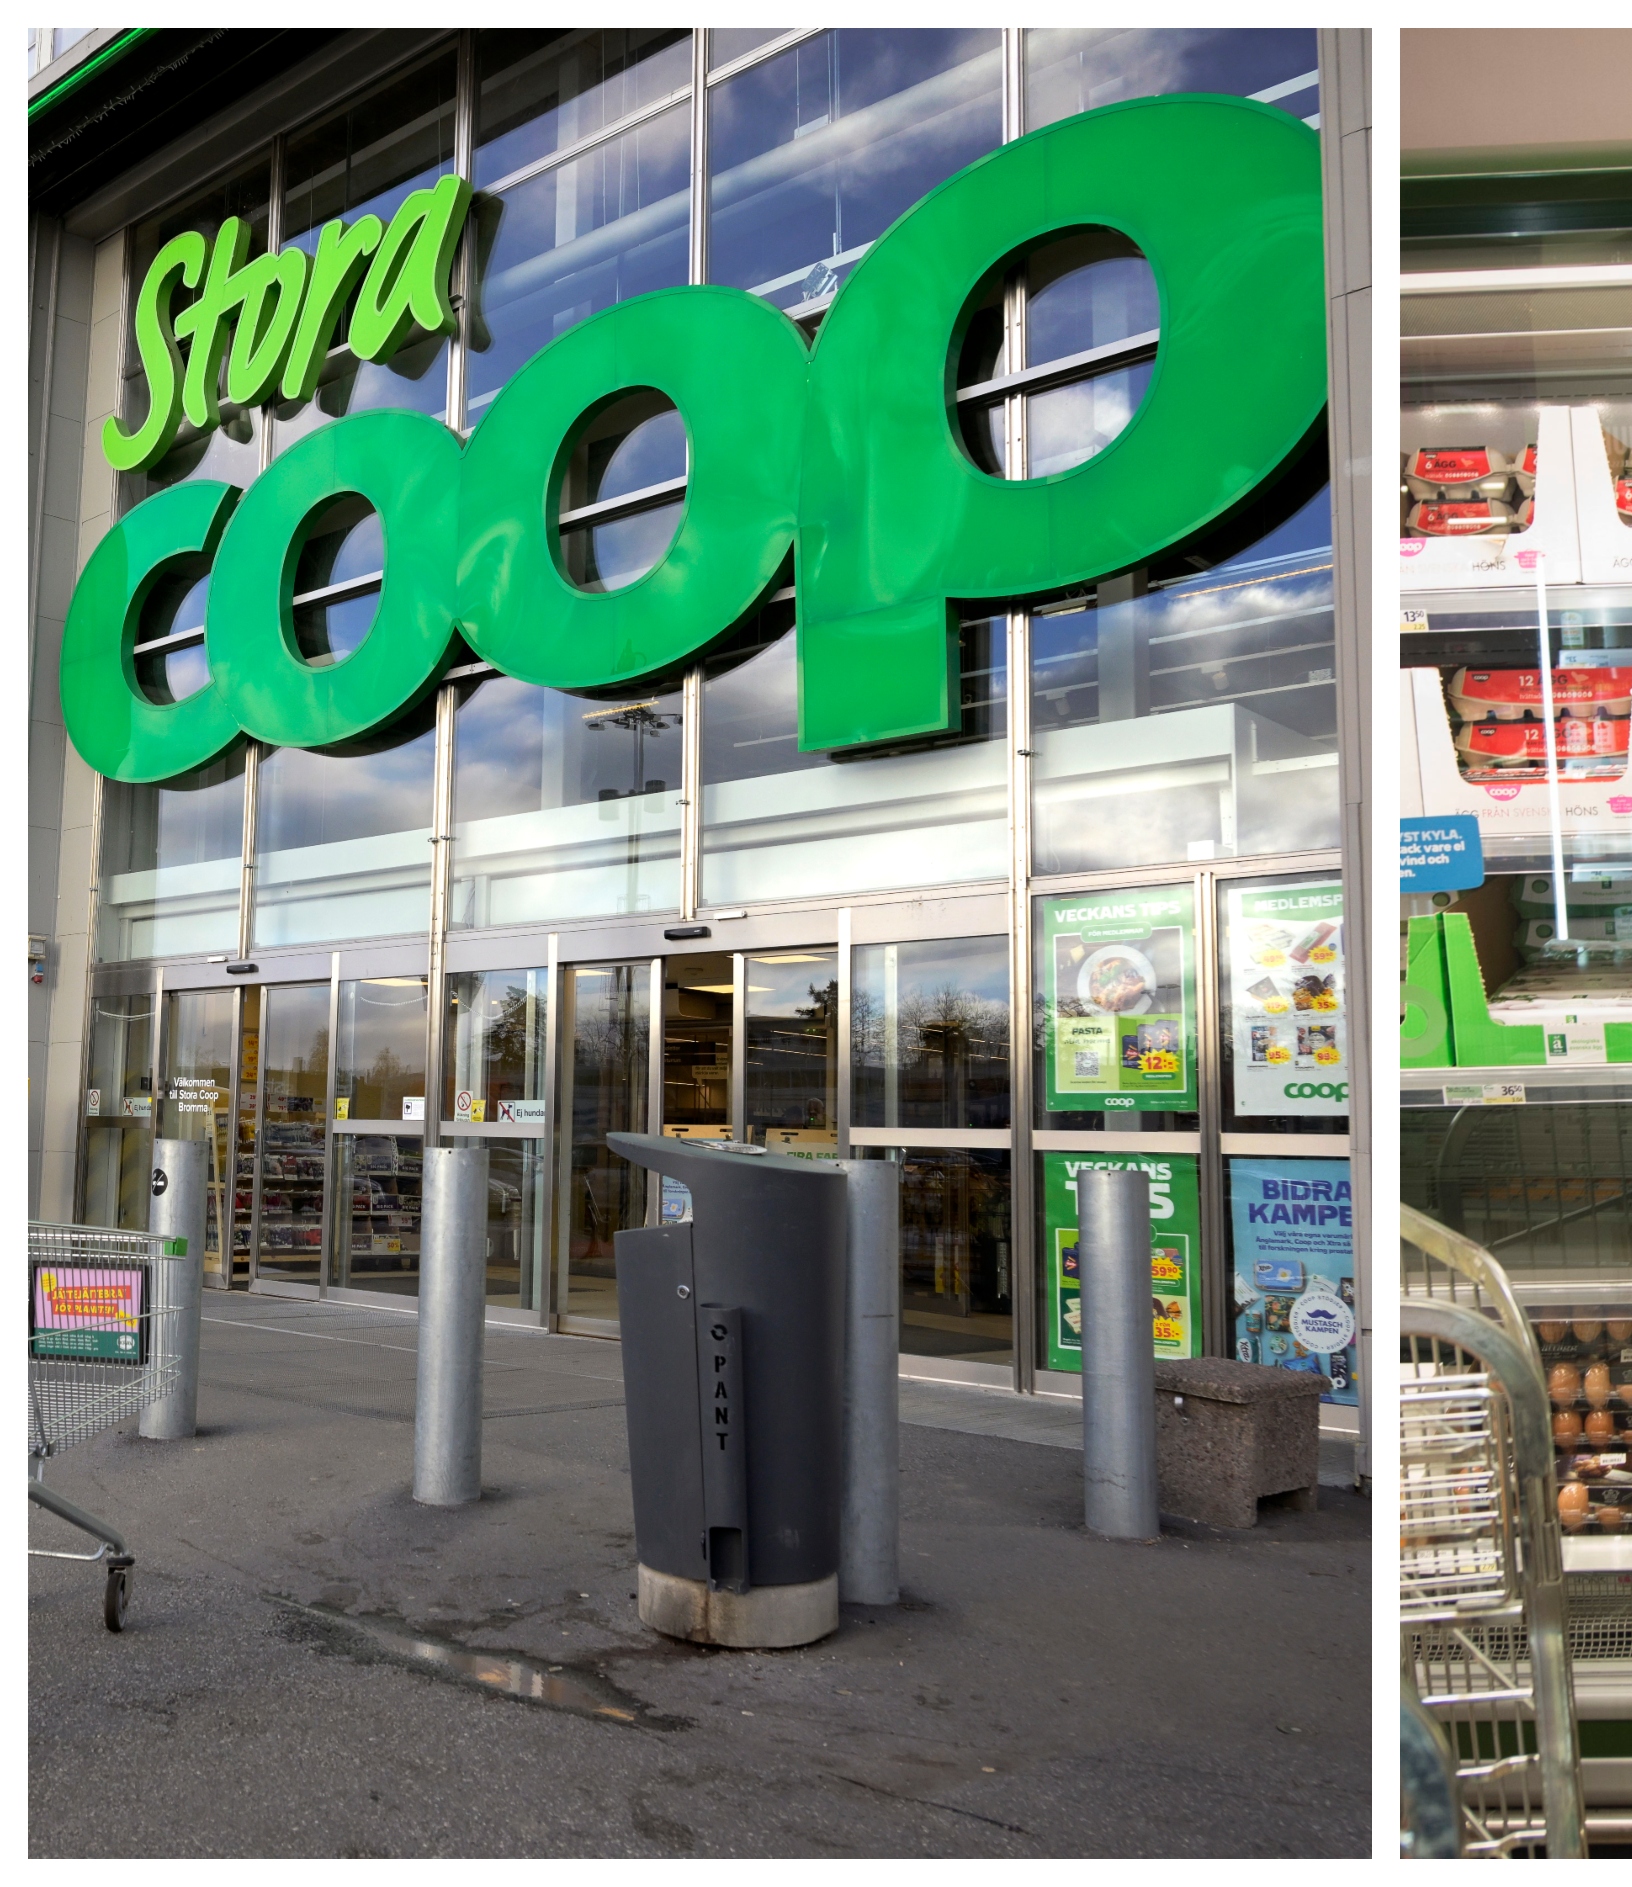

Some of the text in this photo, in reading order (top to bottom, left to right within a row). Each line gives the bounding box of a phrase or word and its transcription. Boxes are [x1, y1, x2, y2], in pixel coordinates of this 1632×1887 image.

[101, 173, 473, 473] Stora
[59, 91, 1328, 784] coop
[1425, 461, 1432, 469] 6
[1428, 513, 1434, 521] 6
[1519, 675, 1534, 687] 12
[1524, 729, 1539, 740] 12
[1489, 788, 1518, 797] coop
[1482, 805, 1599, 817] FRÅN HÖNS
[1421, 829, 1463, 841] KYLA.
[1423, 841, 1465, 853] vare el
[1427, 853, 1450, 864] och
[1055, 900, 1182, 922] VECKANS TIPS
[1072, 1027, 1102, 1035] PASTA
[173, 1077, 215, 1088] Välkommen
[169, 1089, 219, 1102] till Stora Coop
[1501, 1084, 1523, 1096] 3650
[178, 1102, 208, 1112] Bromma
[1105, 1098, 1135, 1107] coop
[516, 1109, 523, 1119] Ej
[1273, 1230, 1287, 1238] Välj
[1256, 1237, 1294, 1245] Änglamark,
[1294, 1238, 1312, 1246] Coop
[1268, 1244, 1308, 1253] forskningen
[1309, 1246, 1328, 1255] kring
[1301, 1319, 1343, 1329] MUSTASCH
[1305, 1325, 1339, 1335] KAMPEN
[714, 1355, 729, 1451] PANT
